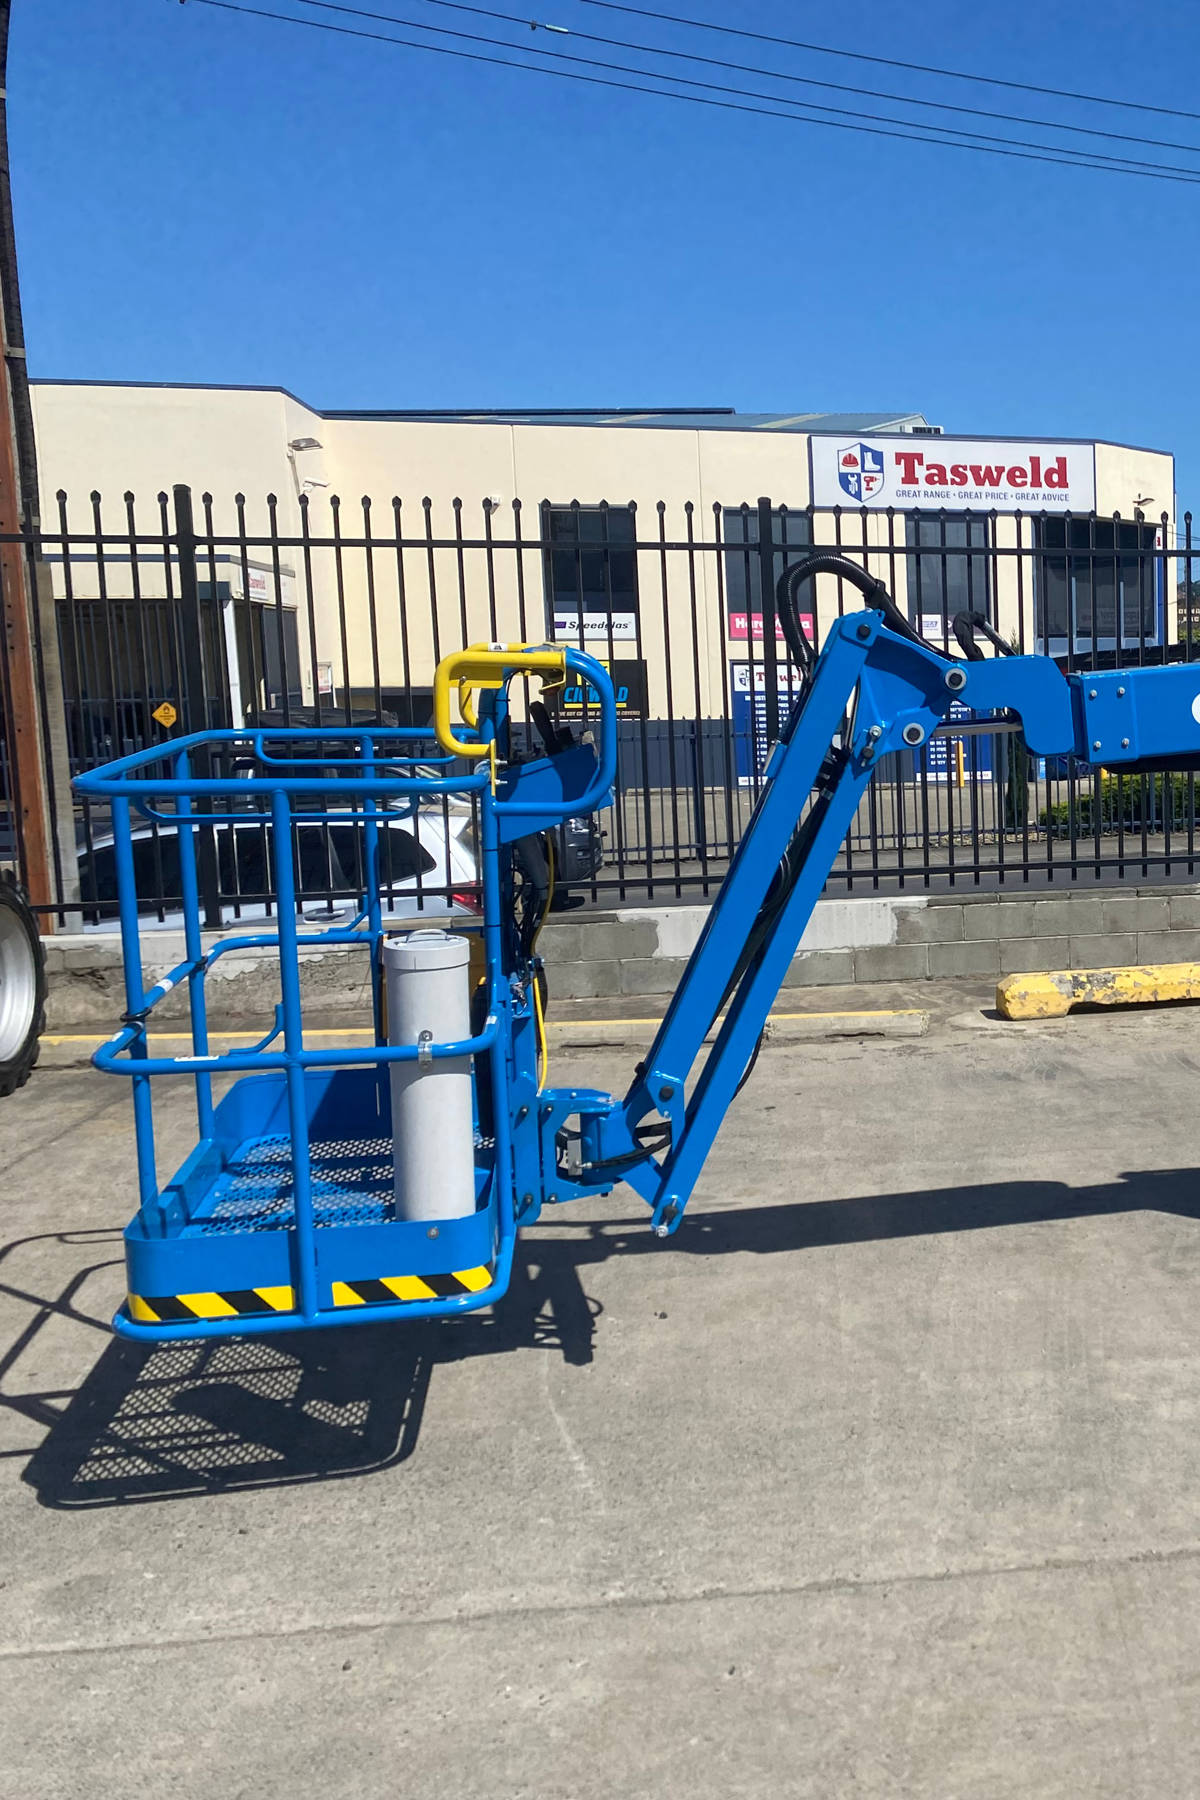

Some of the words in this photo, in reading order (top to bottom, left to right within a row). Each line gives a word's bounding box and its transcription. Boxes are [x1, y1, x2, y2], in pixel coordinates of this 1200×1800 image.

[895, 452, 1069, 488] Tasweld
[896, 489, 922, 498] GREAT
[923, 490, 951, 499] RANGE
[958, 491, 983, 500] GREAT
[985, 492, 1009, 501] PRICE
[1015, 492, 1041, 501] GREAT
[1041, 493, 1070, 502] ADVICE
[756, 669, 802, 682] Twel
[563, 686, 629, 703] CIWD
